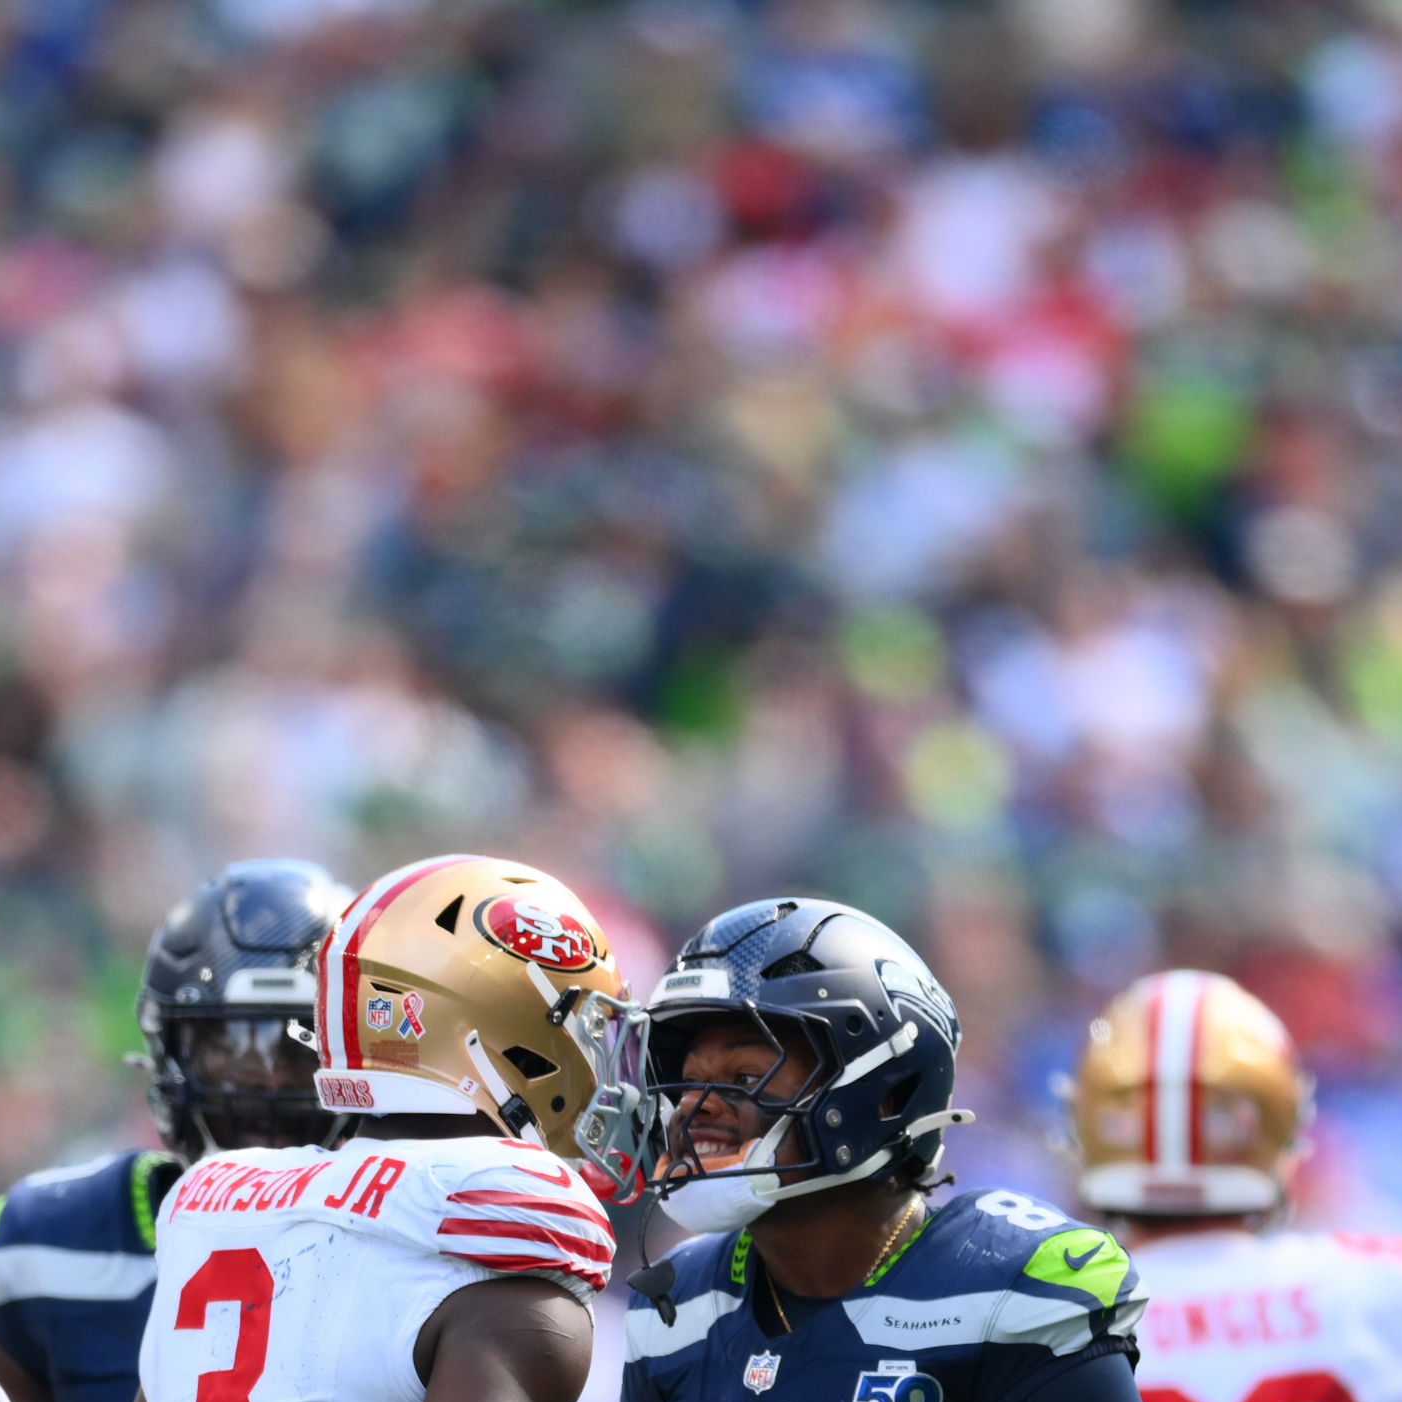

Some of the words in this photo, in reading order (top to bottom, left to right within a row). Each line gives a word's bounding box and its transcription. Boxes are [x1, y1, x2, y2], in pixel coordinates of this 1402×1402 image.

[369, 1010, 390, 1026] NFL
[324, 1155, 406, 1219] JR
[974, 1189, 1069, 1232] 8
[883, 1315, 962, 1331] SEAHAWKS
[749, 1369, 772, 1386] NFL
